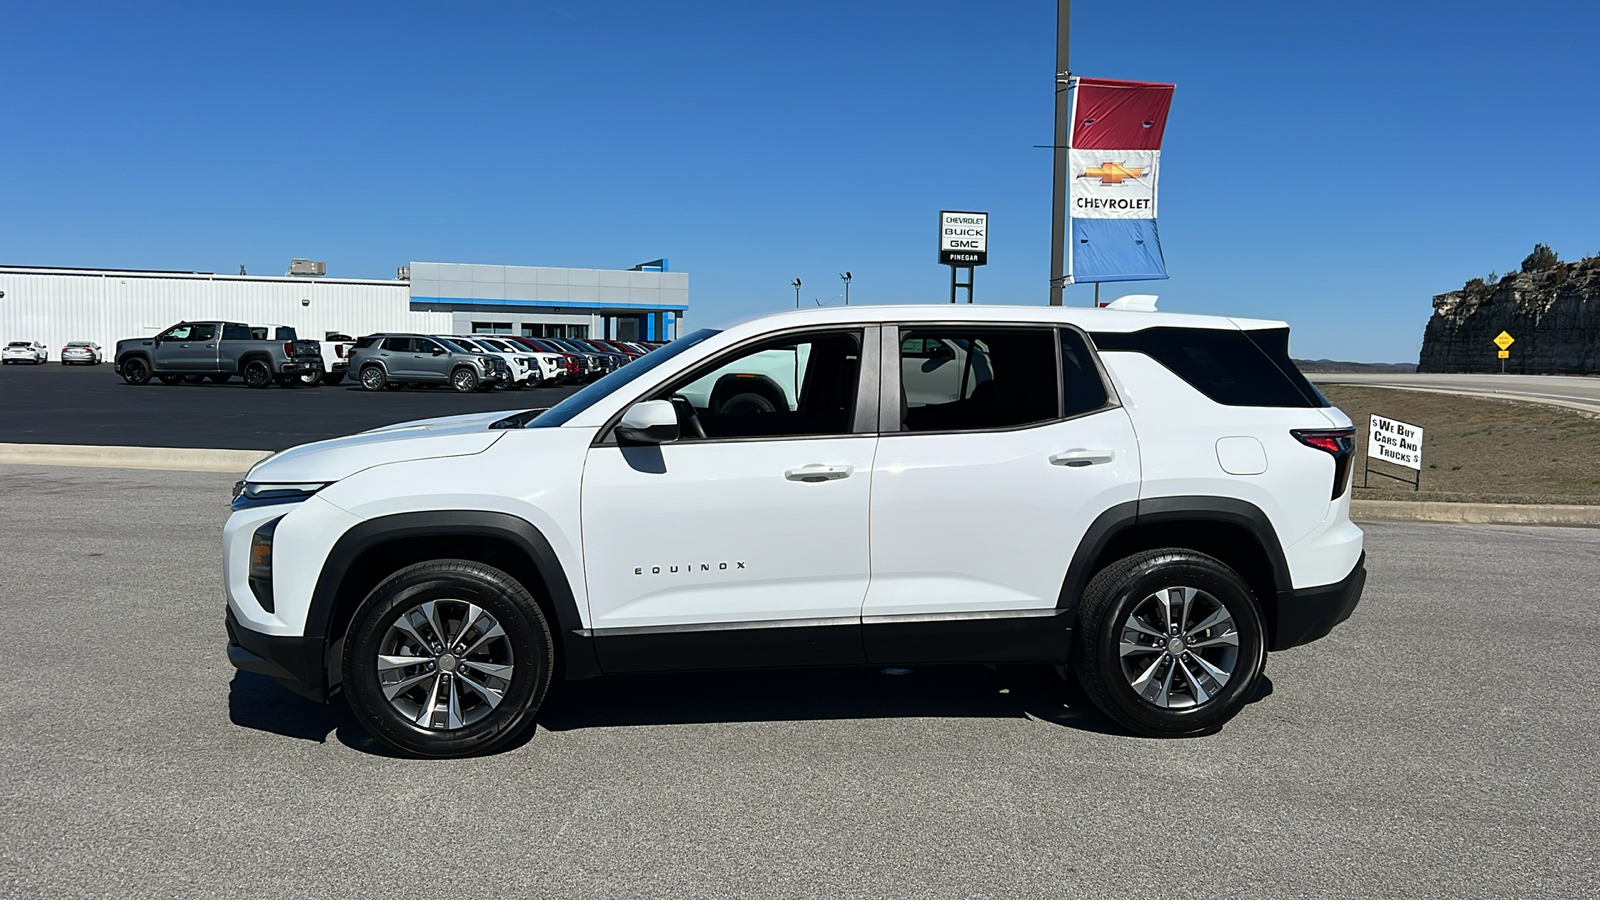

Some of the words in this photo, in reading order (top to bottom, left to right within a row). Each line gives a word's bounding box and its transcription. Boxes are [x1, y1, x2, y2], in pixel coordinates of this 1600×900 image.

[1077, 197, 1150, 209] CHEVROLET
[946, 216, 984, 225] CHEVROLET
[945, 228, 984, 236] BUICK
[950, 240, 978, 248] GMC
[634, 561, 745, 575] EQUINOX
